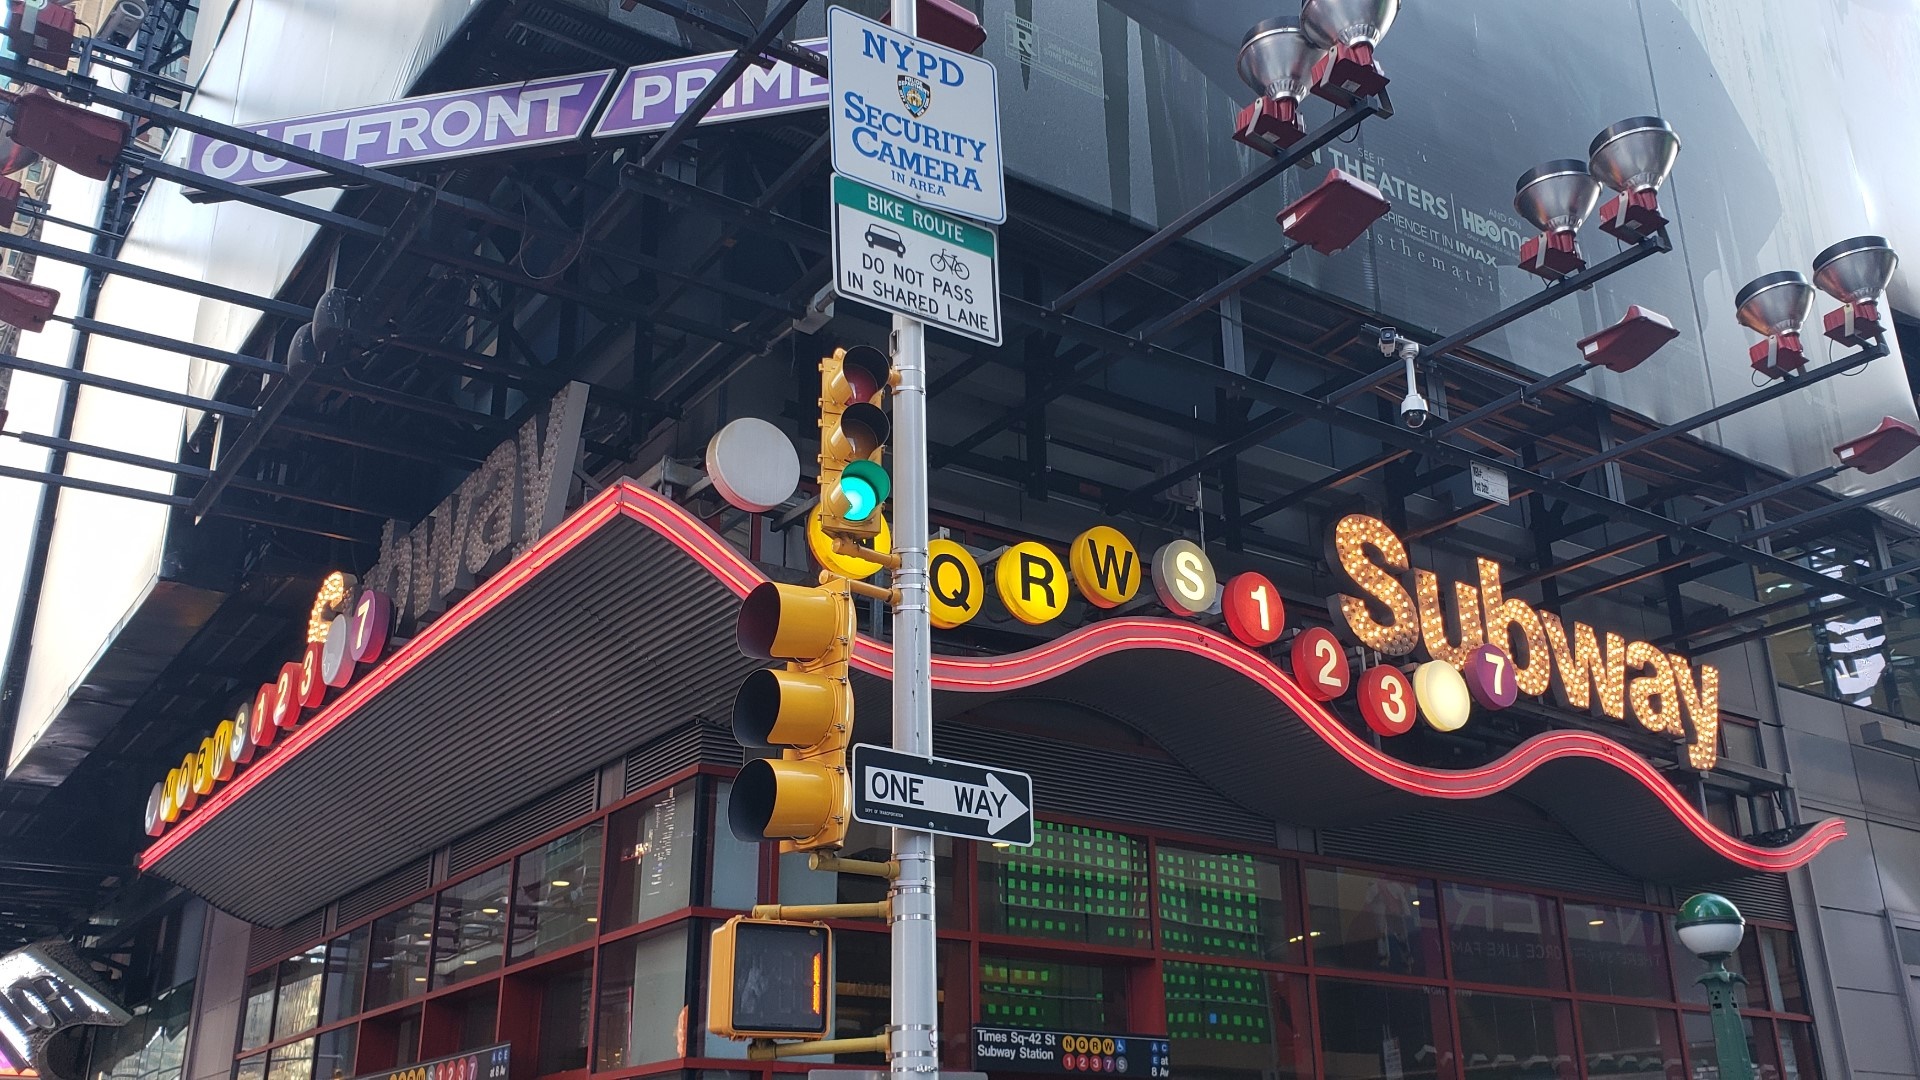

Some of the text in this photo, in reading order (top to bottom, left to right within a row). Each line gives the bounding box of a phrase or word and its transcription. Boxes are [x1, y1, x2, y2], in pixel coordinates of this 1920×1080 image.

[862, 29, 964, 87] NYPD
[201, 83, 584, 180] OUTFRONT
[844, 91, 987, 163] SECURITY
[852, 126, 983, 192] CAMERA
[1357, 147, 1385, 167] SEE IT
[891, 170, 946, 197] IN AREA
[1328, 147, 1449, 220] THEATERS
[867, 192, 964, 243] BIKE ROUTE
[1488, 208, 1522, 231] AND ON
[1429, 230, 1441, 243] IT
[1441, 234, 1454, 250] IN
[1455, 239, 1498, 268] IMAX
[847, 270, 864, 291] IN
[873, 280, 939, 315] SHARED
[947, 304, 989, 332] LANE
[862, 253, 973, 305] DO NOT PASS
[929, 538, 1504, 723] Q R W S 1 2 3 7
[1330, 513, 1719, 770] Subway
[213, 732, 228, 774] W
[232, 712, 245, 752] S
[257, 691, 266, 733] 1
[277, 672, 289, 716] 2
[301, 650, 314, 696] 3
[356, 599, 371, 650] 7
[871, 772, 1008, 818] ONE WAY
[977, 1029, 1056, 1046] Times Sq-42 St
[978, 1044, 1054, 1060] Subway Station
[1066, 1038, 1113, 1051] N Q R W
[1161, 1055, 1169, 1065] at
[1118, 1059, 1125, 1070] S
[1151, 1067, 1169, 1078] 8 Av
